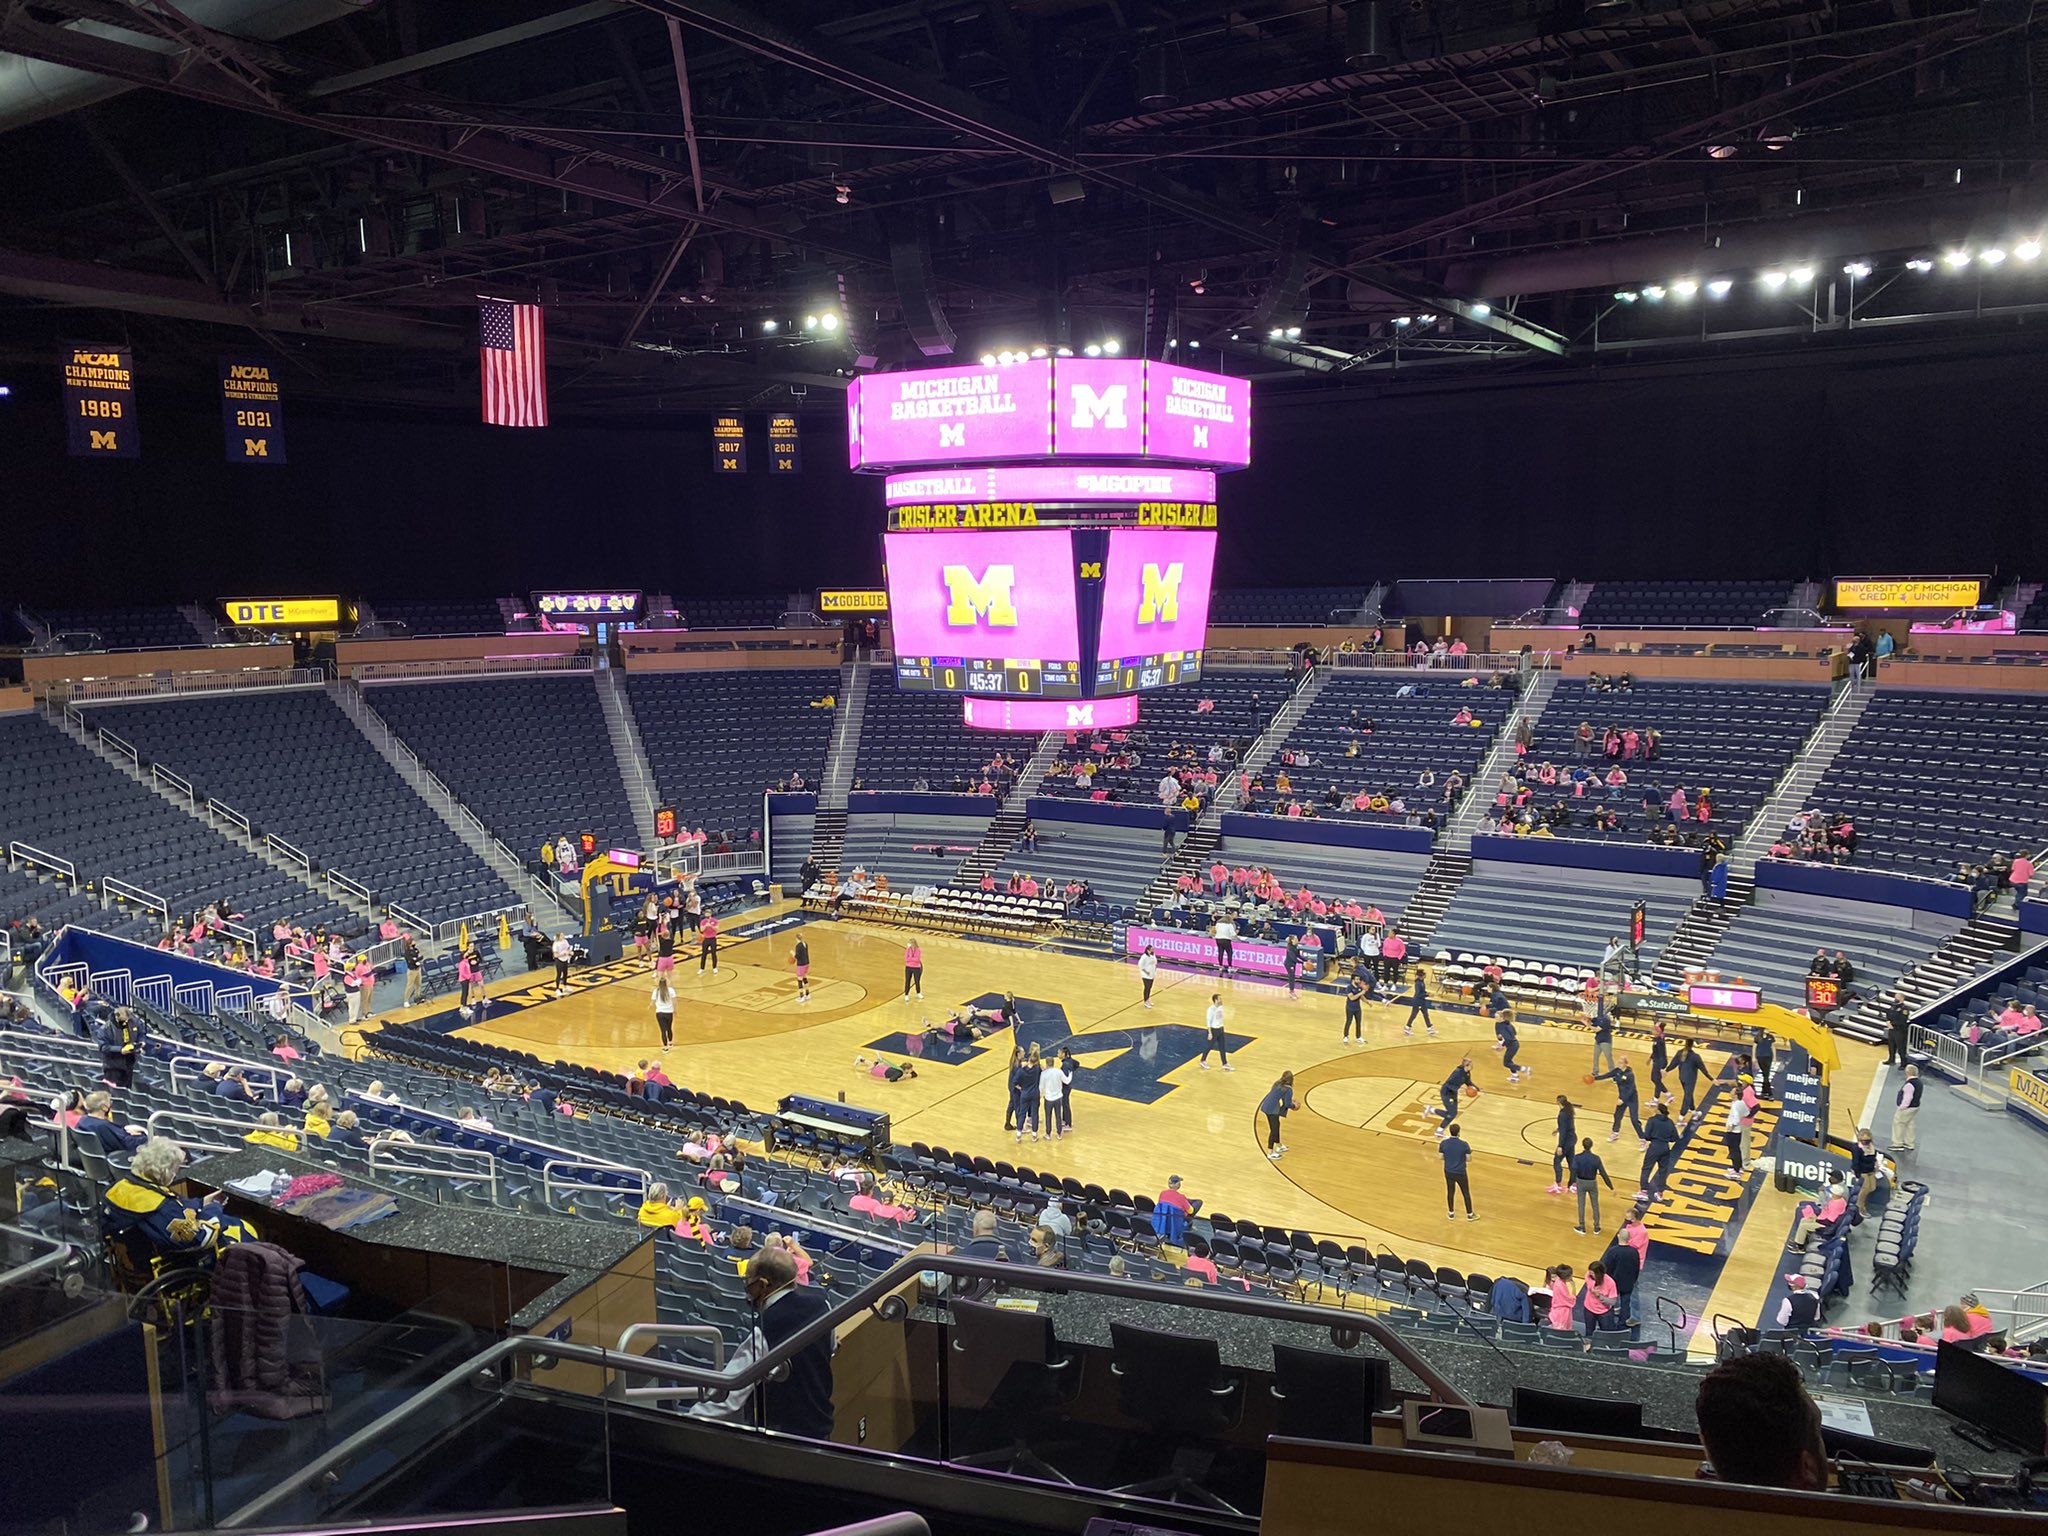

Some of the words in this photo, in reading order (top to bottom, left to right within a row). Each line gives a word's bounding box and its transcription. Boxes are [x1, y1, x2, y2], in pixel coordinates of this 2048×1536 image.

[73, 350, 119, 367] NCAA
[65, 365, 130, 381] CHAMPIONS
[231, 365, 269, 380] NCAA
[88, 380, 131, 390] BASKETBALL
[224, 380, 278, 392] CHAMPIONS
[900, 374, 999, 400] MICHIGAN
[1172, 376, 1226, 402] MICHIGAN
[80, 400, 122, 418] 1989
[891, 393, 1016, 420] BASKETBALL
[1071, 384, 1128, 429] M
[1165, 394, 1234, 423] BASKETBALL
[237, 411, 272, 427] 2021
[772, 419, 795, 427] NCAA
[90, 431, 117, 449] M
[939, 422, 965, 447] M
[244, 439, 268, 456] M
[719, 443, 740, 452] 2017
[774, 443, 795, 452] 2021
[723, 459, 737, 469] M
[779, 459, 792, 469] M
[893, 477, 976, 497] BASKETBALL
[899, 504, 958, 528] CRISLER
[962, 502, 1039, 527] ARENA
[1138, 502, 1200, 526] CRISLER
[1080, 562, 1101, 578] M
[943, 564, 1018, 626] M
[1137, 562, 1183, 624] M
[1840, 583, 1901, 593] UNIVERSITY
[1906, 583, 1919, 592] OF
[1923, 583, 1977, 592] MICHIGAN
[1859, 592, 1895, 601] CREDIT
[1914, 592, 1949, 601] UNION
[238, 605, 284, 620] DTE
[986, 660, 993, 670] 2
[1067, 662, 1078, 671] 00
[945, 668, 956, 689] 0
[969, 672, 1003, 691] 45:37
[1018, 671, 1029, 692] 0
[1070, 674, 1076, 683] 4
[1126, 669, 1133, 688] 0
[1141, 668, 1161, 687] 45:37
[1168, 663, 1176, 682] 0
[1066, 704, 1094, 726] M
[658, 819, 673, 834] 30
[1138, 935, 1201, 954] MICHIGAN
[1809, 981, 1837, 992] 45:36
[1815, 991, 1831, 1003] 30
[1787, 1073, 1819, 1086] meijer
[1784, 1091, 1817, 1104] meijer
[1783, 1109, 1815, 1123] meijer
